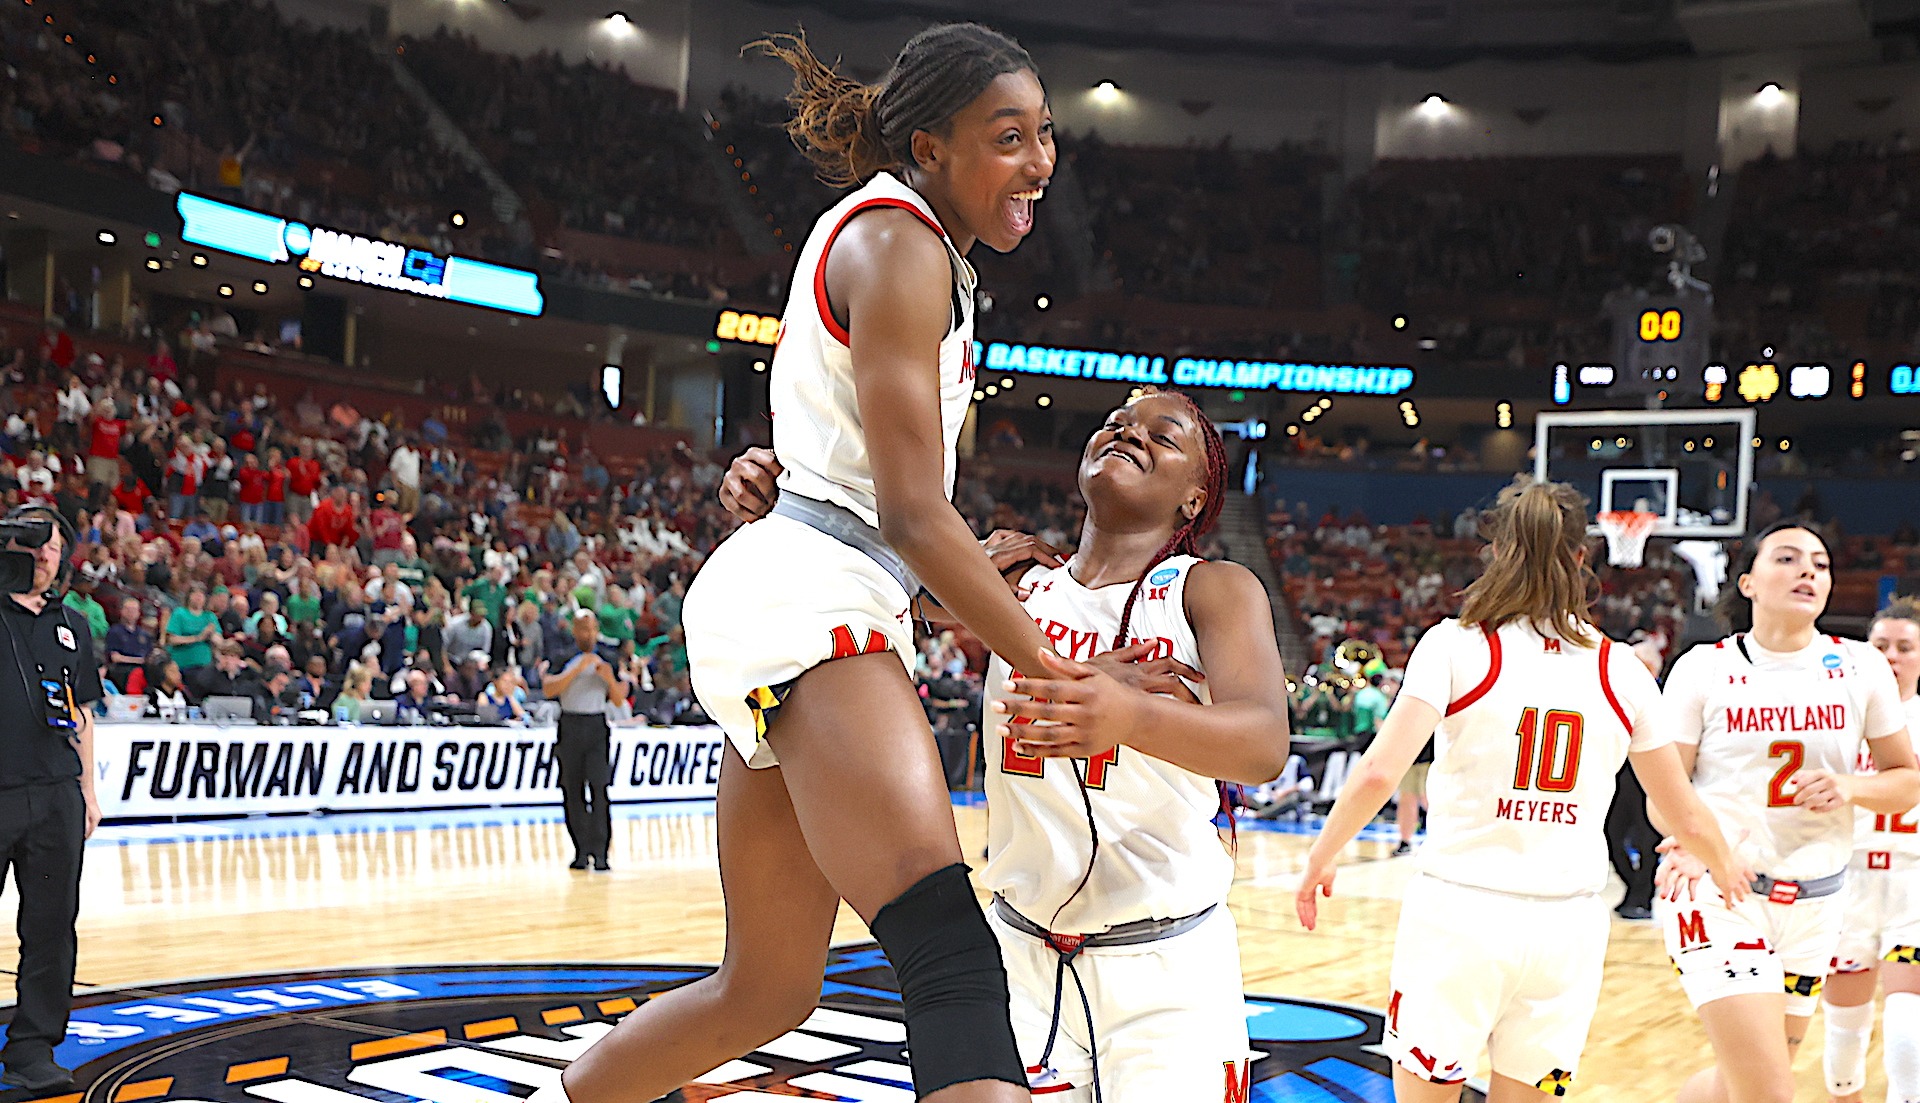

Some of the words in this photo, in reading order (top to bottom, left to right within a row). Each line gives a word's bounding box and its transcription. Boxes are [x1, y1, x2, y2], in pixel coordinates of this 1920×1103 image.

[1640, 309, 1682, 341] 00
[717, 310, 781, 345] 202
[985, 342, 1168, 384] BASKETBALL
[1173, 357, 1414, 395] CHAMPIONSHIP
[1726, 704, 1846, 733] MARYLAND
[121, 741, 329, 801] FURMAN
[336, 741, 422, 794] AND
[1513, 706, 1584, 792] 10
[1767, 739, 1805, 807] 2
[1496, 797, 1578, 825] MEYERS
[1677, 909, 1711, 949] M
[112, 979, 420, 1023] ELITE
